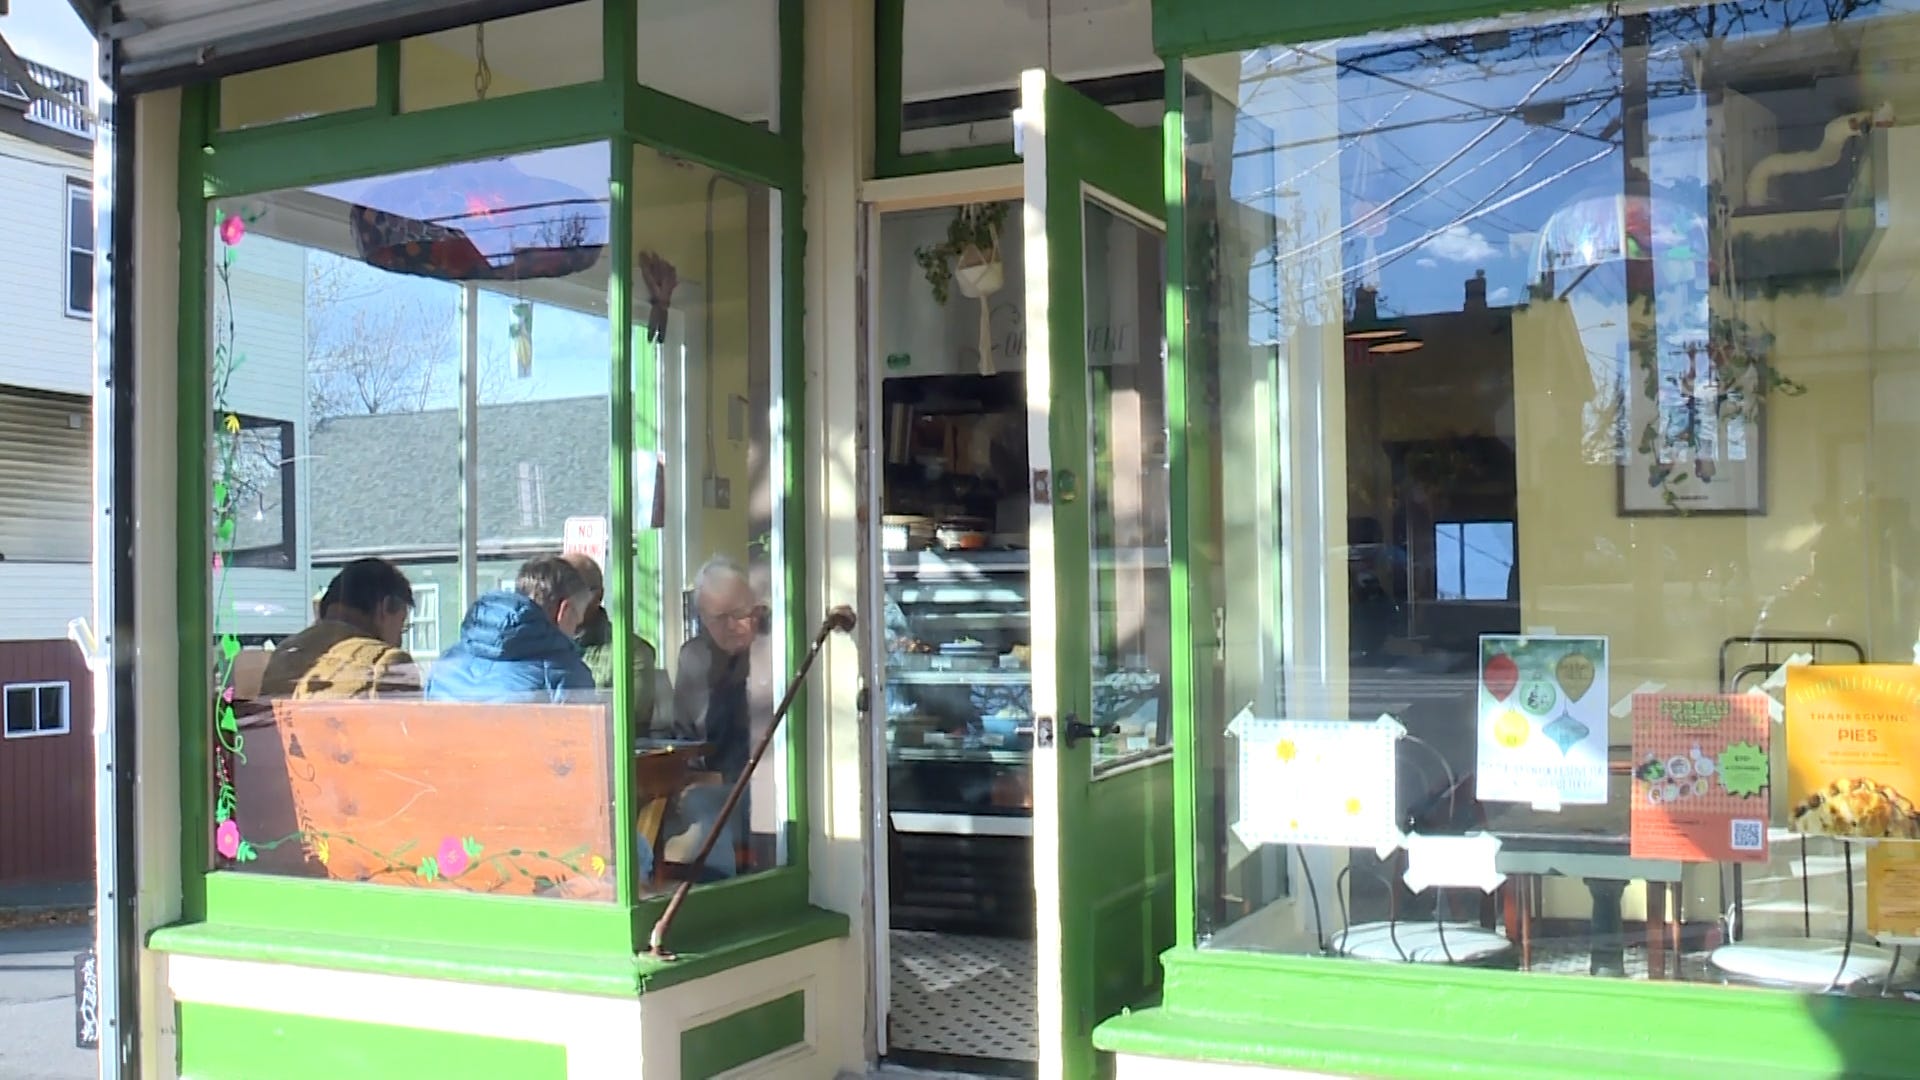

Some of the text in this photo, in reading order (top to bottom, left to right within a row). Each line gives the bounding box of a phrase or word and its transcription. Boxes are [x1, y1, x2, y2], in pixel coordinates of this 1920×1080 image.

[578, 524, 593, 538] NO
[1810, 712, 1908, 722] THANKSGIVING
[1837, 728, 1878, 742] PIES
